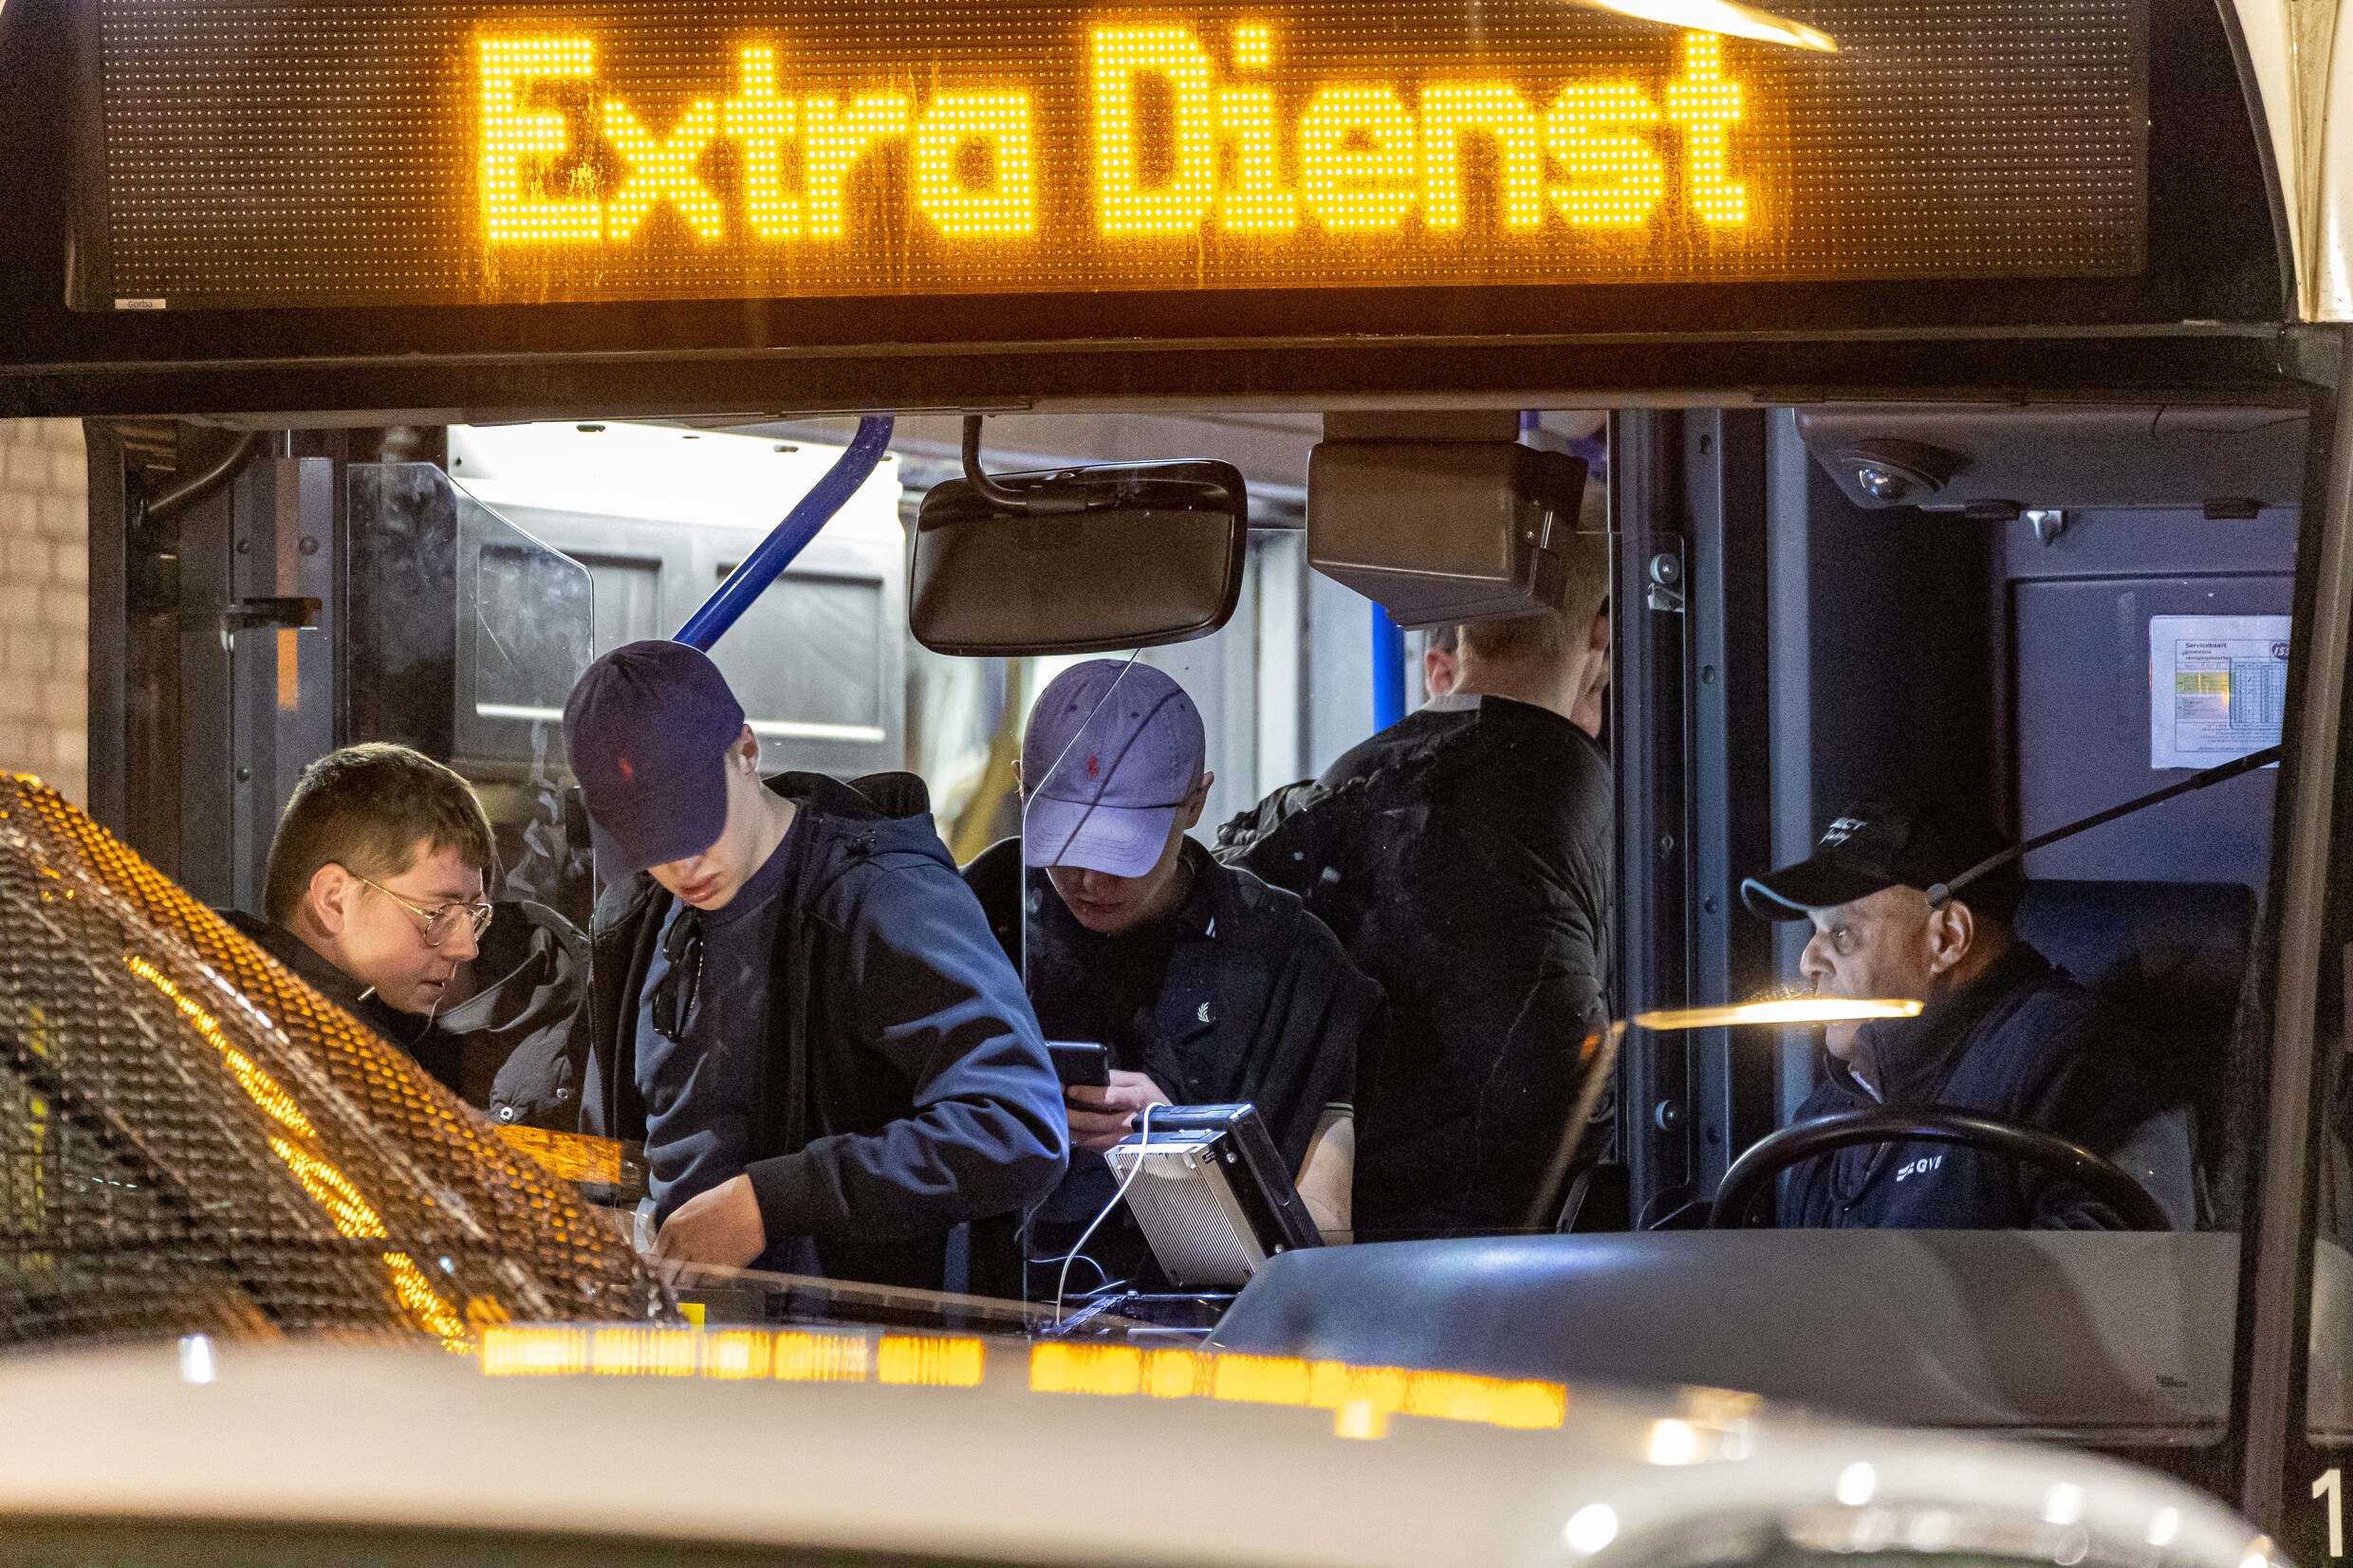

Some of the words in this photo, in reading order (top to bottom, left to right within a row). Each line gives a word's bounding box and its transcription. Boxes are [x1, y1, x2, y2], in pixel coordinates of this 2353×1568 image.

[477, 38, 1036, 243] Extra
[1092, 26, 1750, 232] Dienst
[2312, 1468, 2344, 1558] 1
